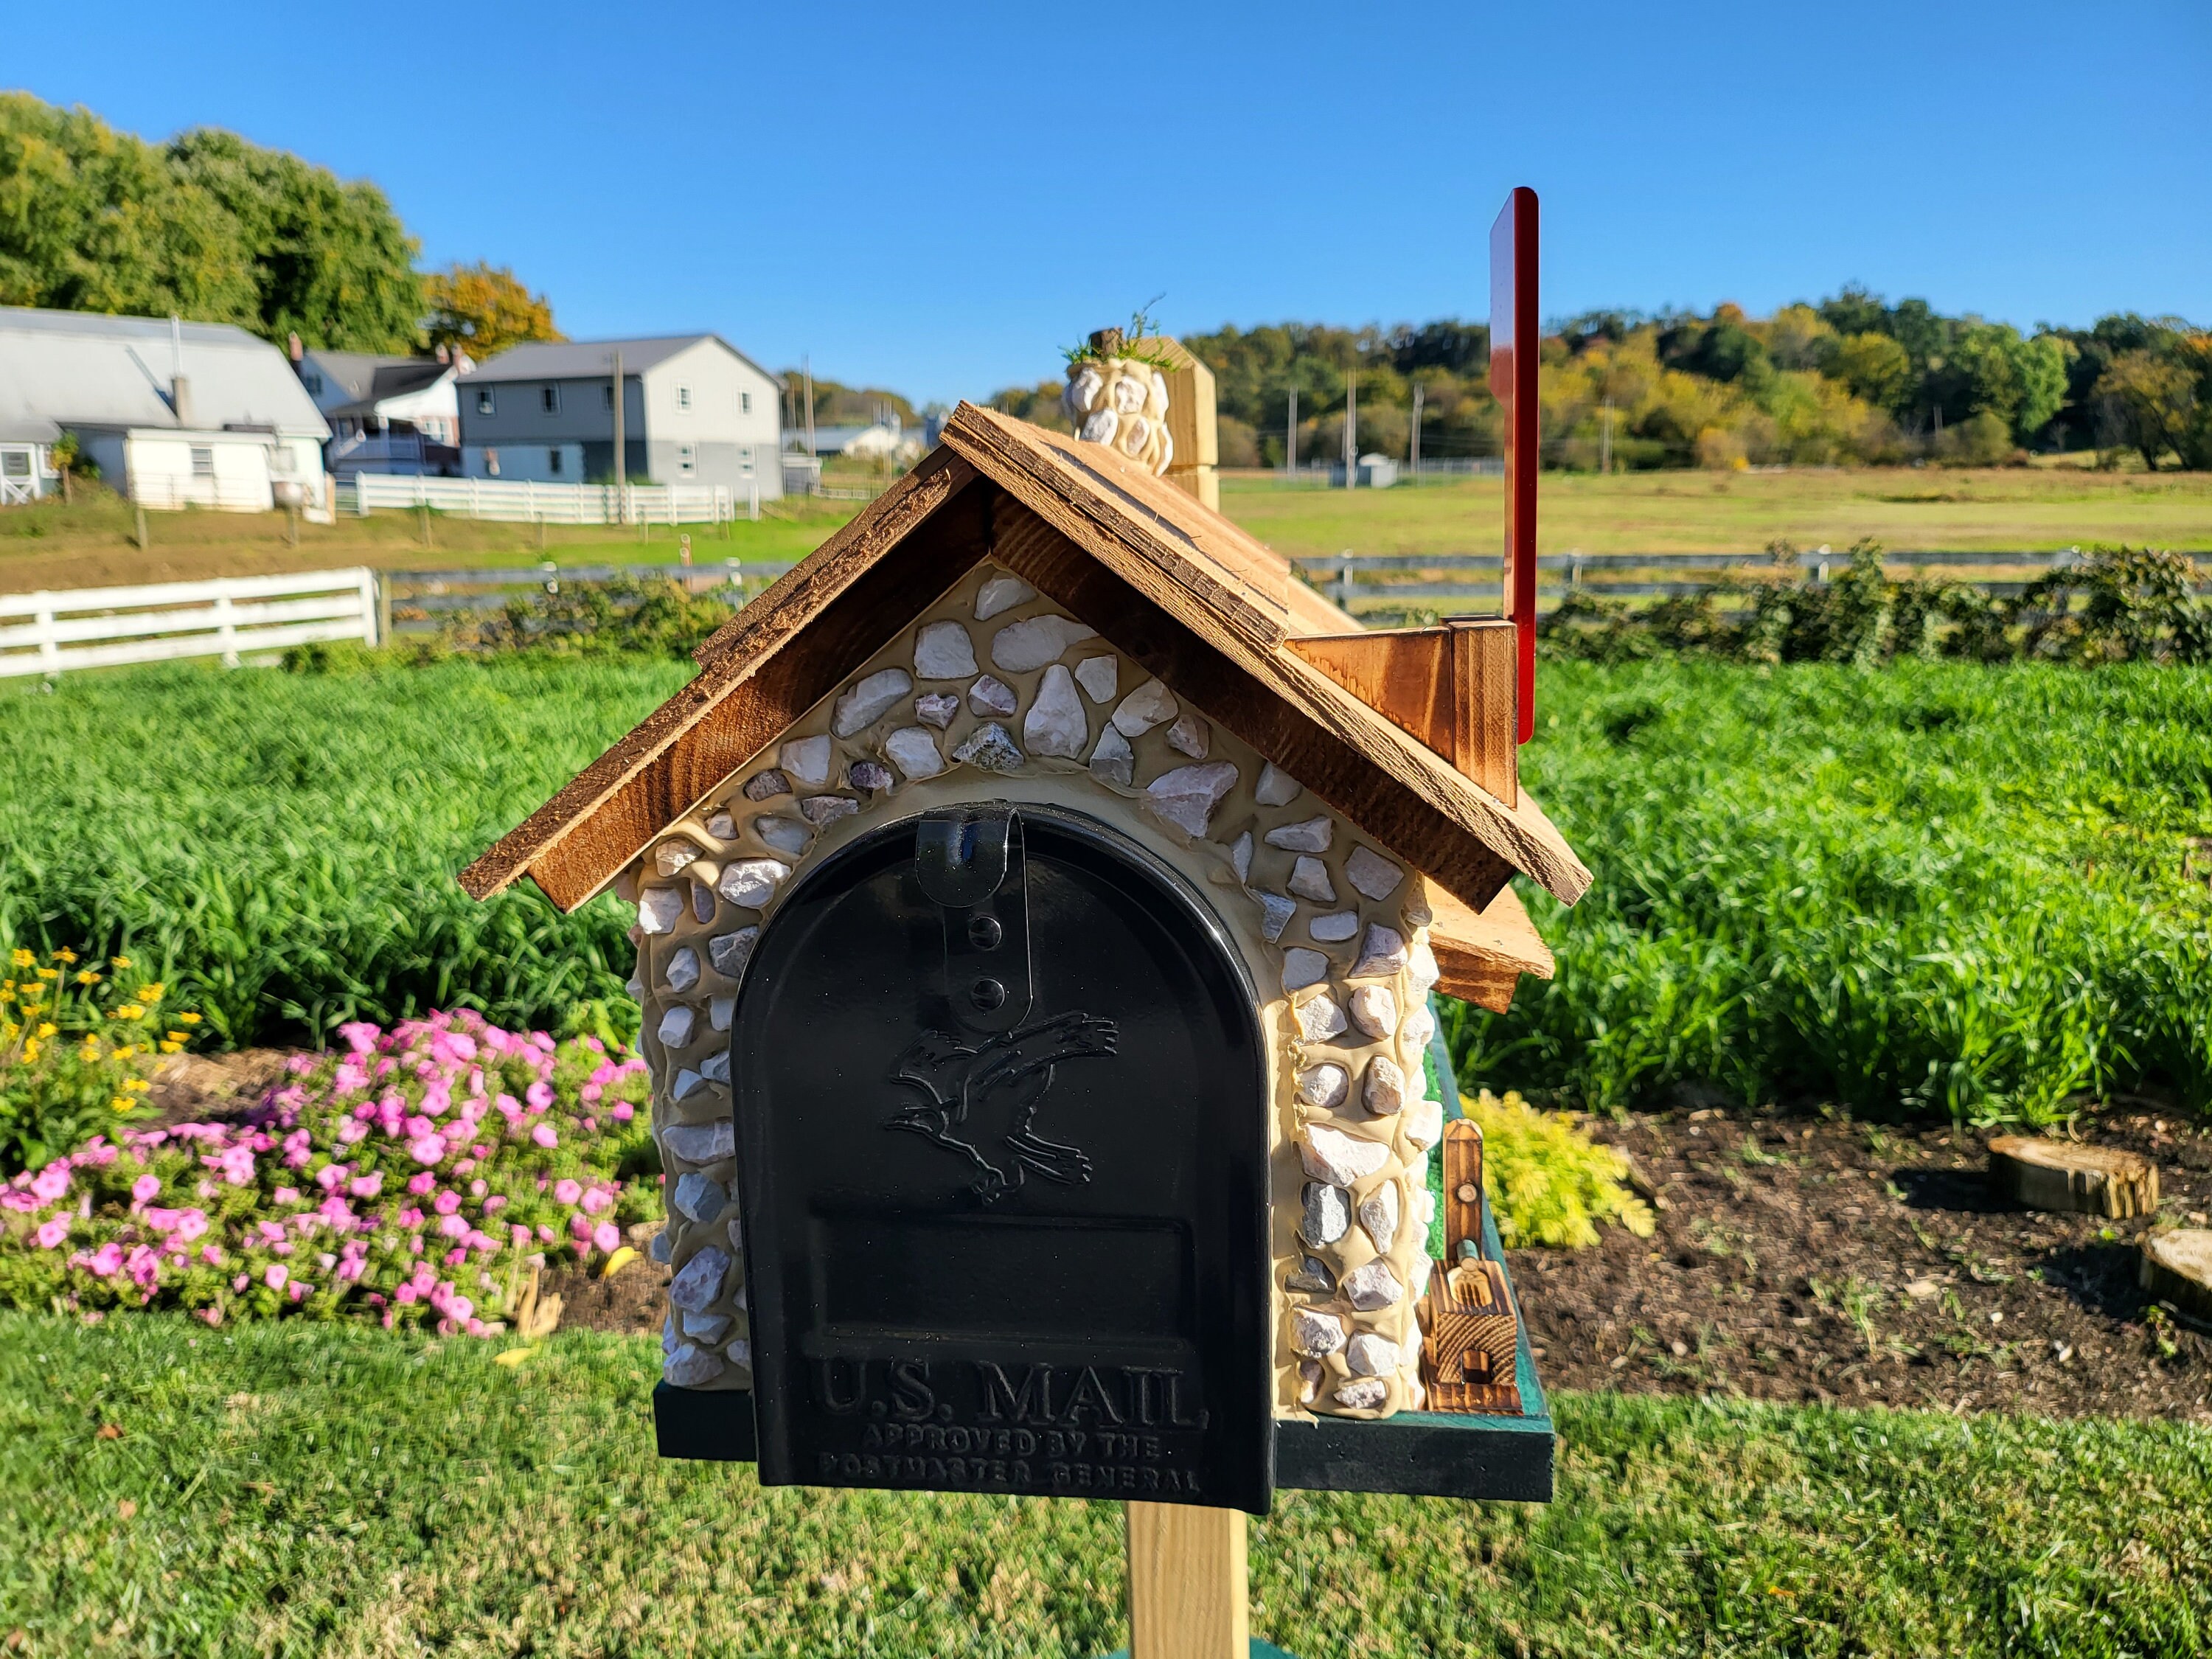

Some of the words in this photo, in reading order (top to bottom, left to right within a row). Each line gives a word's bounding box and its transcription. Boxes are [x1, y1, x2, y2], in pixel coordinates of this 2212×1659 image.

[821, 1357, 954, 1422] U.S.
[974, 1360, 1211, 1431] MAIL
[860, 1422, 1037, 1457] APPROVED
[1046, 1428, 1088, 1458] BY
[1096, 1432, 1161, 1460] THE
[817, 1450, 1032, 1486] POSTMASTER
[1050, 1460, 1202, 1493] GENERAL
